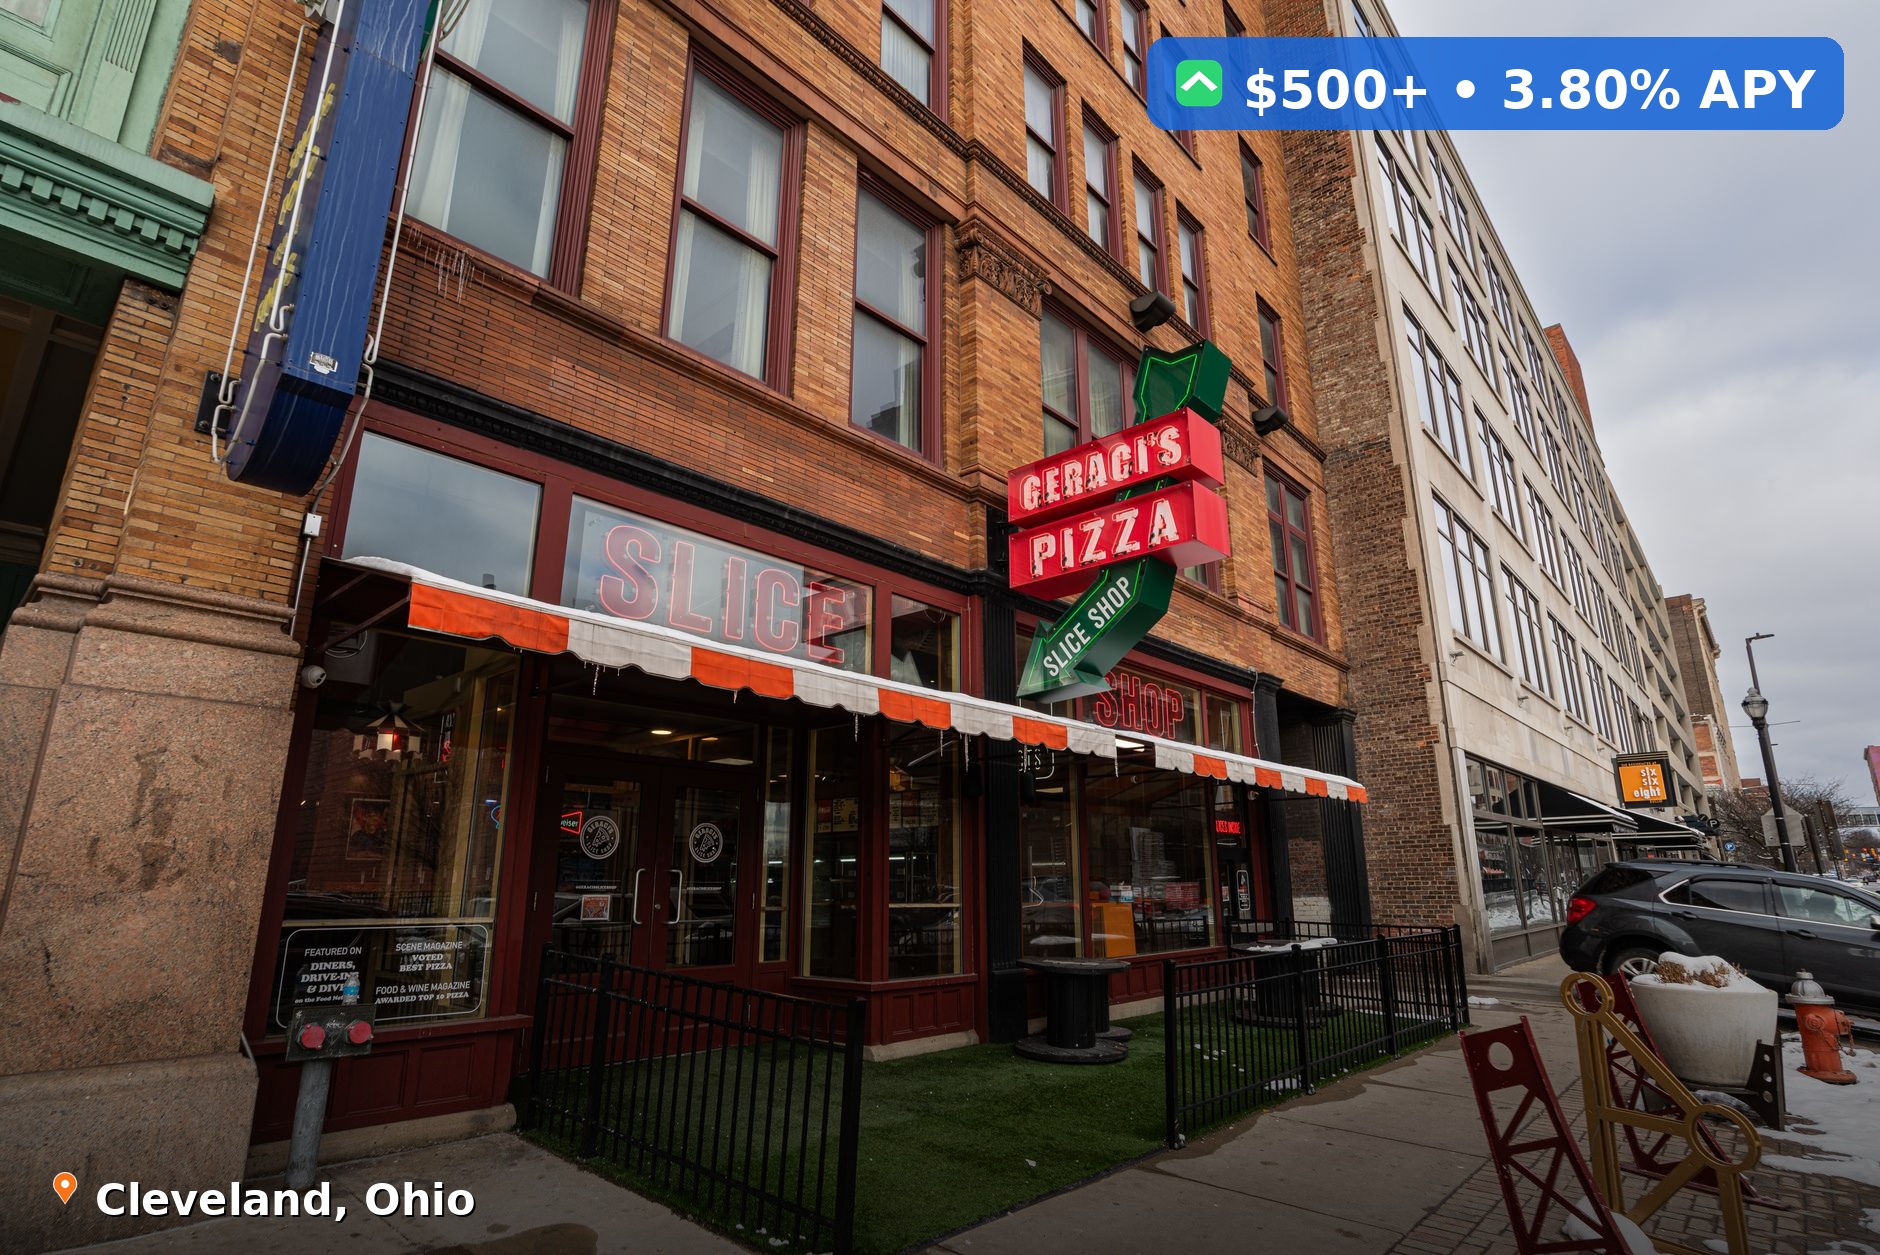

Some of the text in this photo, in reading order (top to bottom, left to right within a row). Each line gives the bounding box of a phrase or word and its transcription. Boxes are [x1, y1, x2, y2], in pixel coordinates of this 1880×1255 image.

[1020, 425, 1183, 511] GERACI'S
[1029, 498, 1180, 579] PIZZA
[600, 525, 845, 663] SLICE
[1043, 576, 1131, 677] SLICE SHOP
[1096, 671, 1185, 739] SHOP
[1640, 767, 1657, 777] six
[1642, 776, 1659, 786] six
[1633, 786, 1661, 800] eight
[1709, 819, 1718, 828] P
[304, 947, 362, 957] FEATURED ON
[395, 941, 463, 952] SCENE MAGAZINE
[412, 953, 443, 962] VOTED
[310, 961, 356, 971] DINERS,
[399, 962, 453, 973] BEST PIZZA
[306, 984, 317, 993] &
[375, 980, 471, 995] FOOD & WINE MAGAZINE
[374, 995, 417, 1005] AWARDED
[418, 993, 434, 1002] TOP
[446, 991, 470, 999] PIZZA
